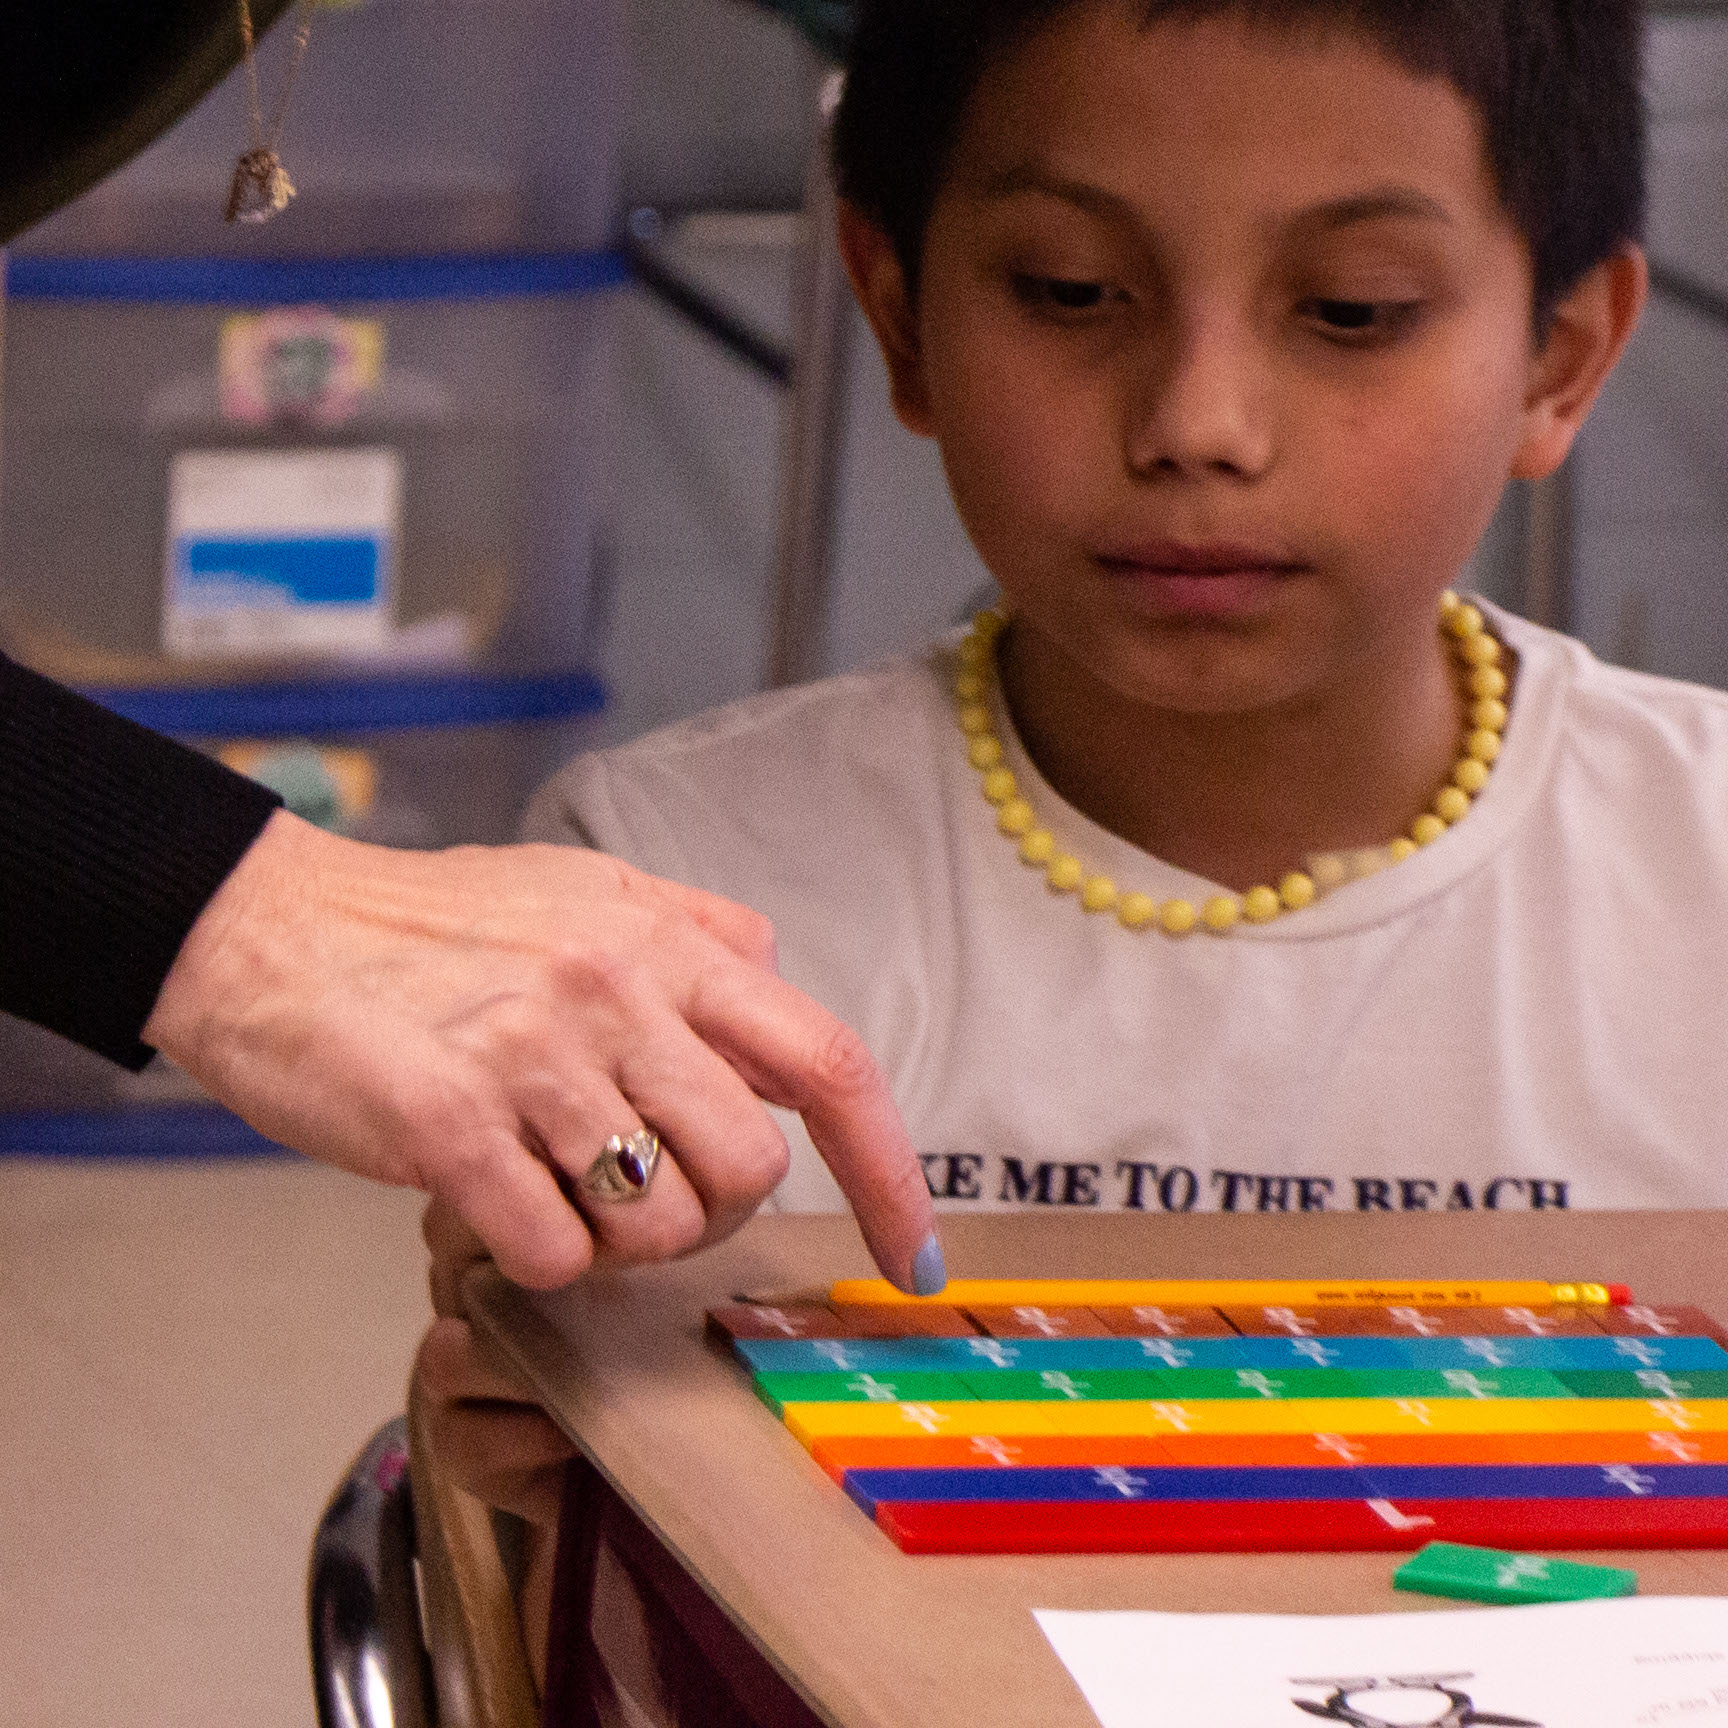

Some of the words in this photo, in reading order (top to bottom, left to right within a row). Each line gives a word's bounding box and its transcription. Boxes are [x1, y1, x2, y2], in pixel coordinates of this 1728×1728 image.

[999, 1156, 1102, 1206] ME
[1116, 1160, 1199, 1212] TO
[1212, 1169, 1334, 1212] THE
[1352, 1175, 1570, 1212] BEACH
